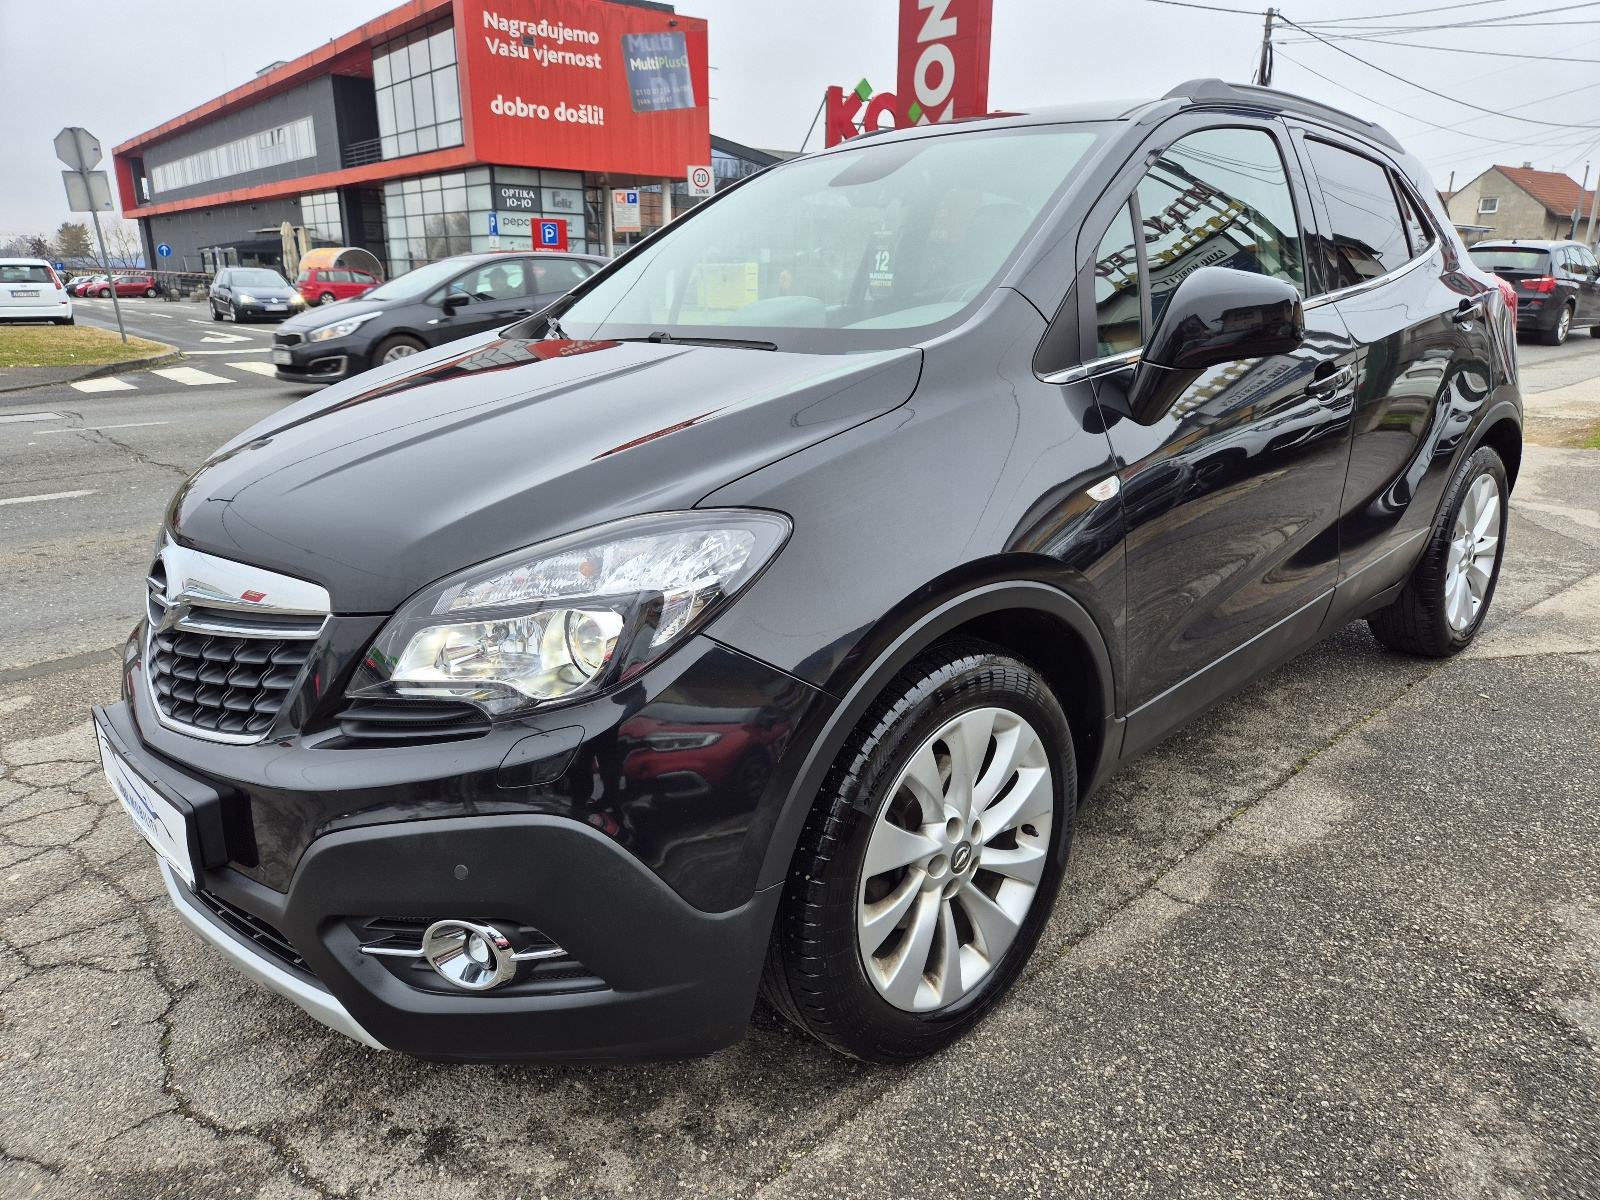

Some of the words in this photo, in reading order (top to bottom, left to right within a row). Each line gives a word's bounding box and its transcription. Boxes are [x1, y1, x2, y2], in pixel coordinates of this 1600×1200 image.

[482, 10, 600, 45] Nagrađujemo
[485, 36, 529, 60] Vašu
[532, 46, 602, 69] vjernost
[490, 94, 550, 120] dobro
[553, 101, 605, 125] došli!
[696, 173, 707, 183] 20
[501, 188, 535, 199] OPTIKA
[628, 193, 635, 202] P
[490, 216, 496, 232] P
[503, 217, 530, 227] pepc
[544, 228, 555, 242] P
[875, 251, 890, 271] 12
